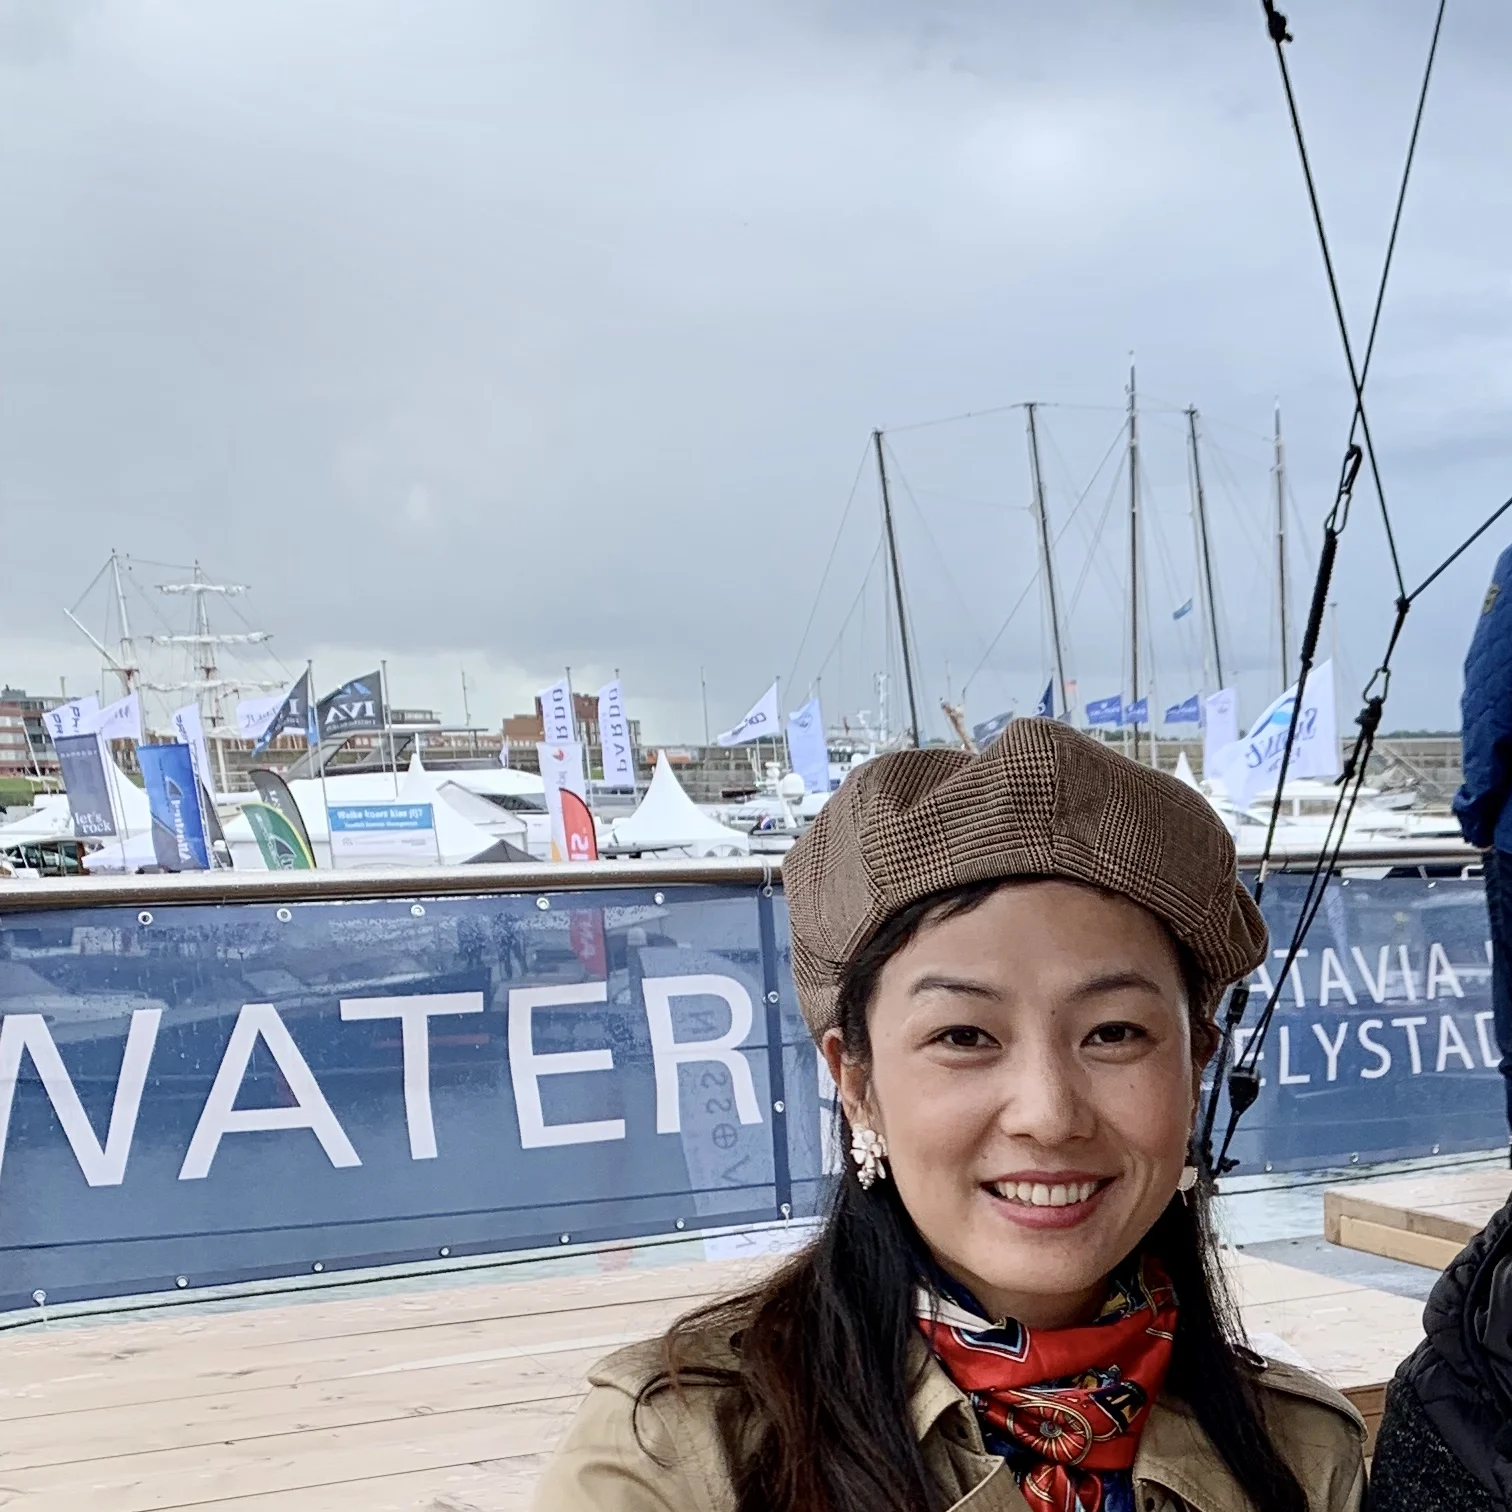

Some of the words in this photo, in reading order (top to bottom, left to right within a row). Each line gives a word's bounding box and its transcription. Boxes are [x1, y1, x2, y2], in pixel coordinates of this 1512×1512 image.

[75, 811, 102, 826] let's
[82, 818, 112, 833] rock
[0, 973, 763, 1187] WATER
